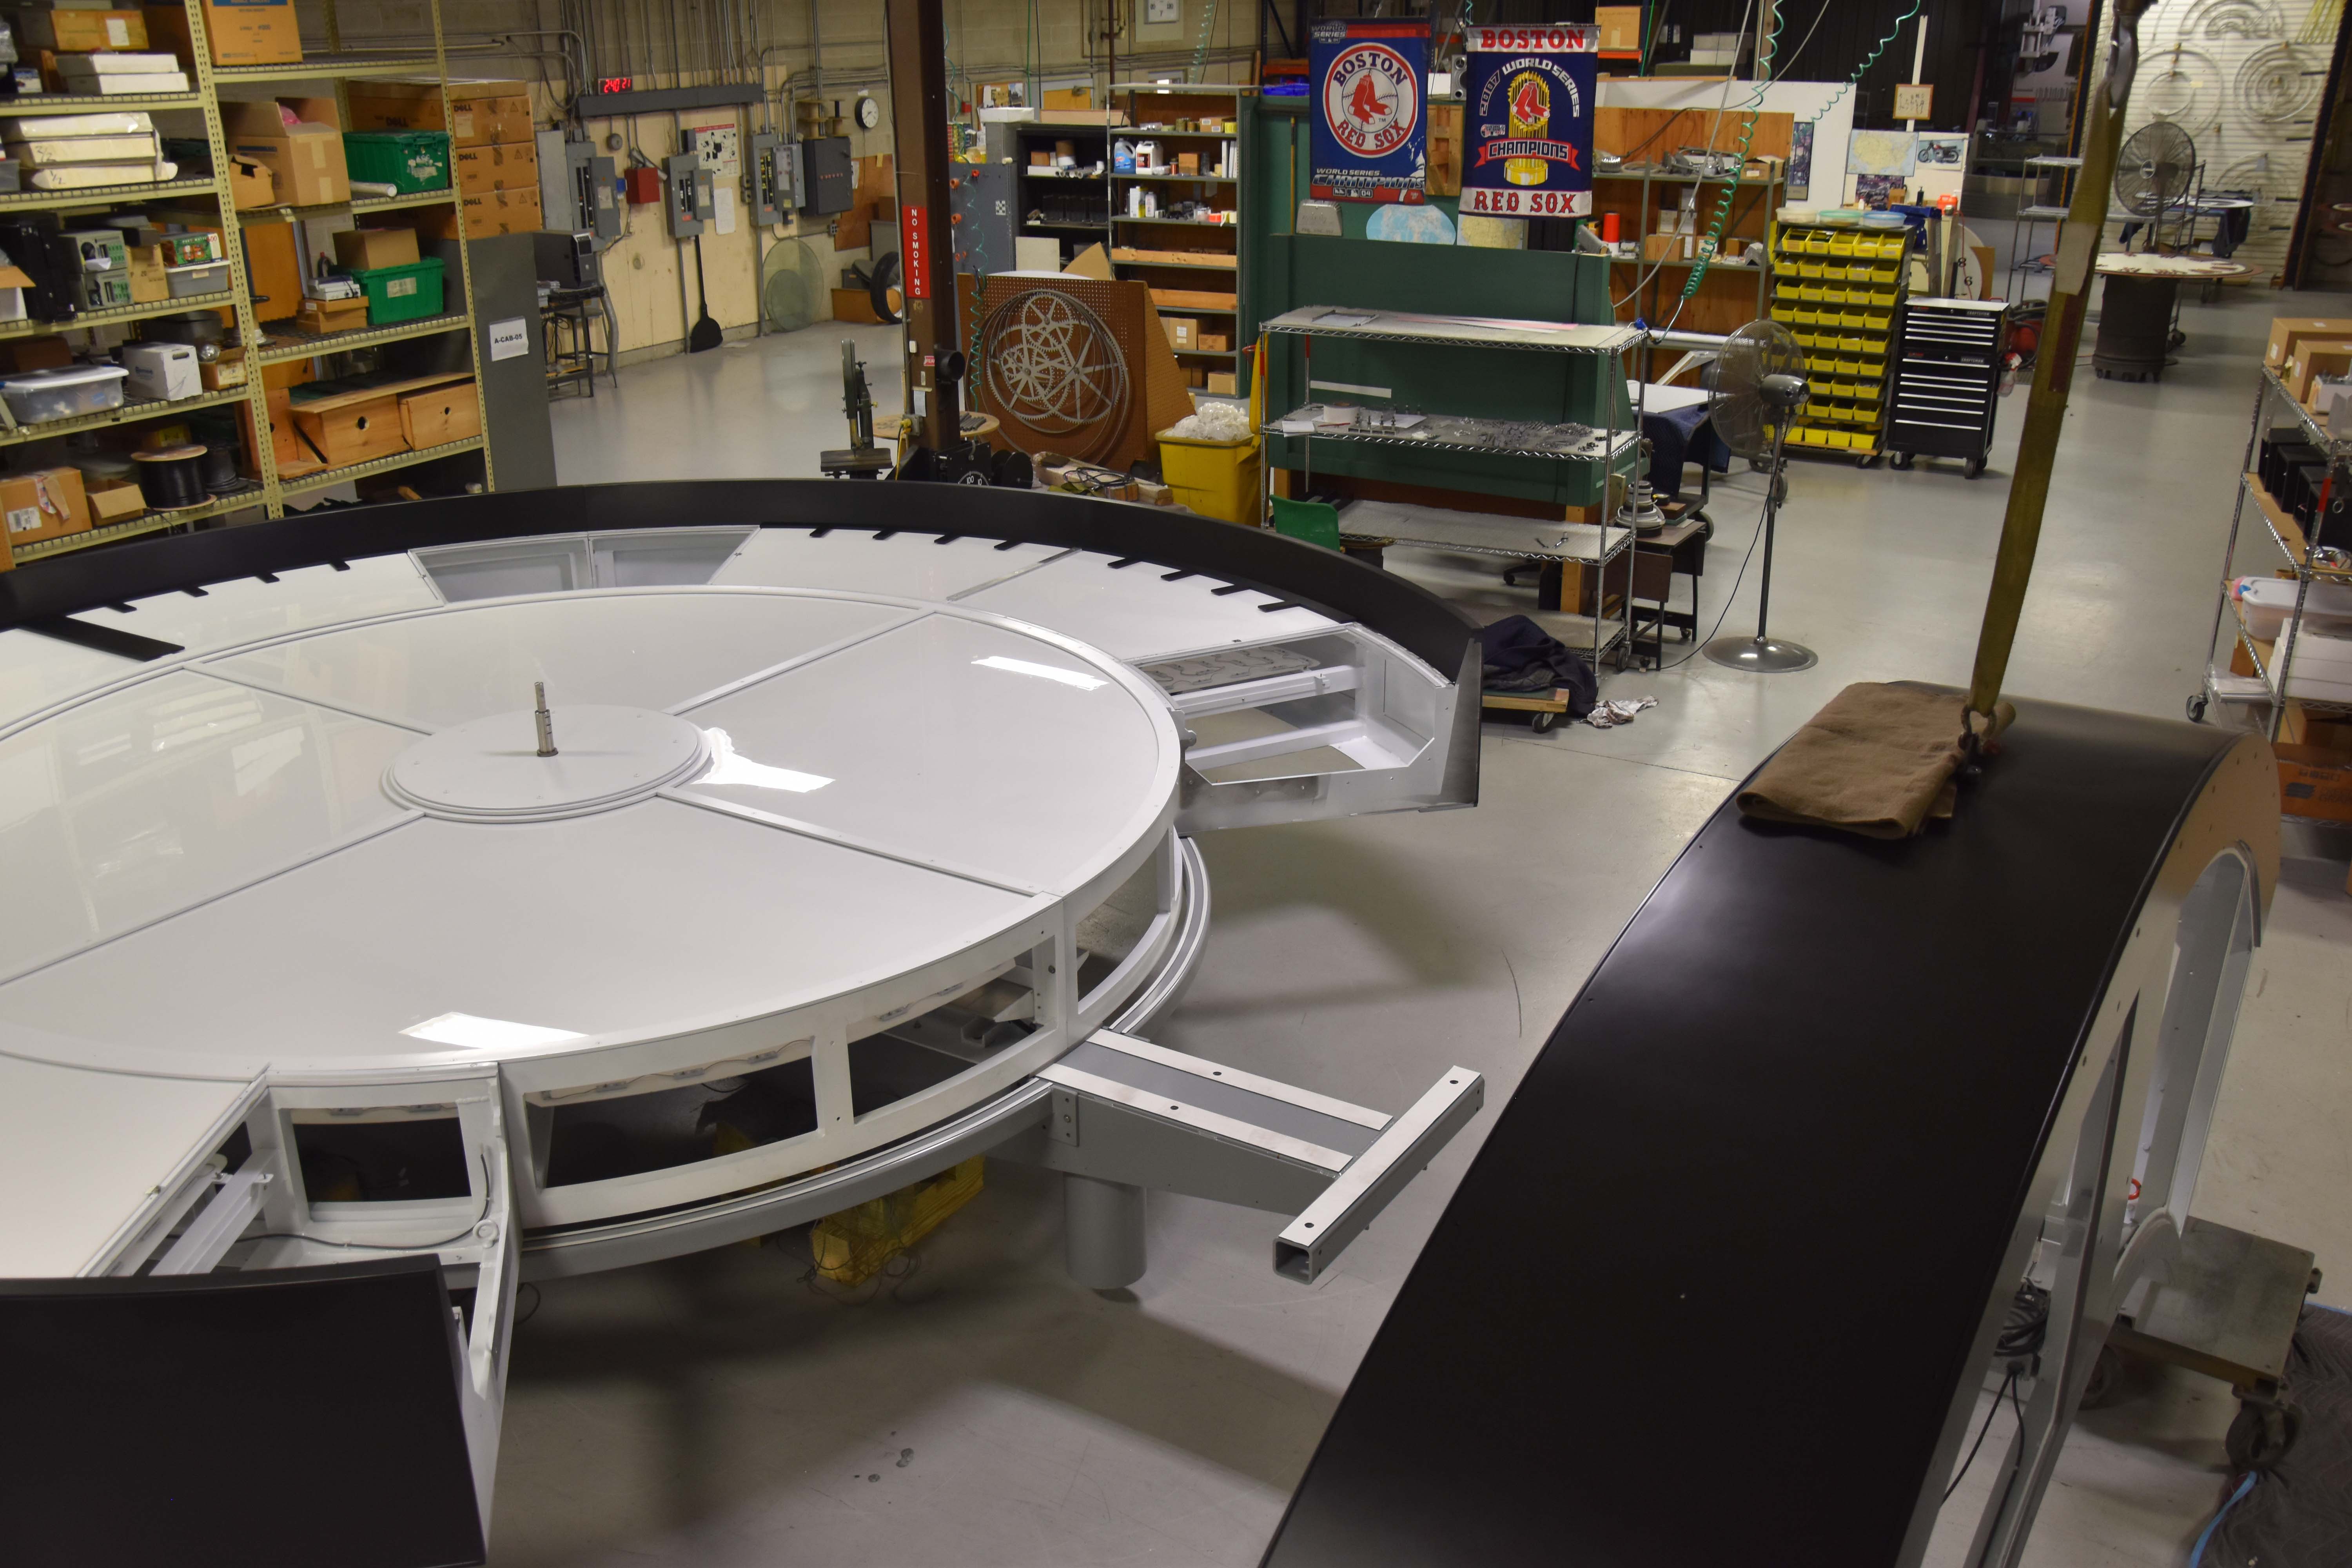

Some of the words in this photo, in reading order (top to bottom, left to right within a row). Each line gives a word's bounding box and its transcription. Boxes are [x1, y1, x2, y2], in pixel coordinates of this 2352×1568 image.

[1481, 29, 1584, 49] BOSTON
[1333, 52, 1408, 87] BOSTON
[1479, 69, 1500, 116] 2007
[1502, 58, 1552, 75] WORLD
[1552, 64, 1579, 117] SERIES
[454, 103, 472, 112] DELL
[1337, 119, 1366, 148] RED
[1374, 118, 1406, 149] SOX
[459, 153, 478, 162] DELL
[1488, 140, 1568, 161] CHAMPIONS
[1312, 174, 1425, 189] CHAMPIONS
[463, 198, 483, 207] DELL
[1474, 191, 1520, 212] RED
[1530, 192, 1576, 214] SOX
[911, 209, 917, 226] NO
[1958, 258, 1966, 267] 8
[1964, 276, 1973, 286] 6
[495, 334, 523, 344] A-CAB-05
